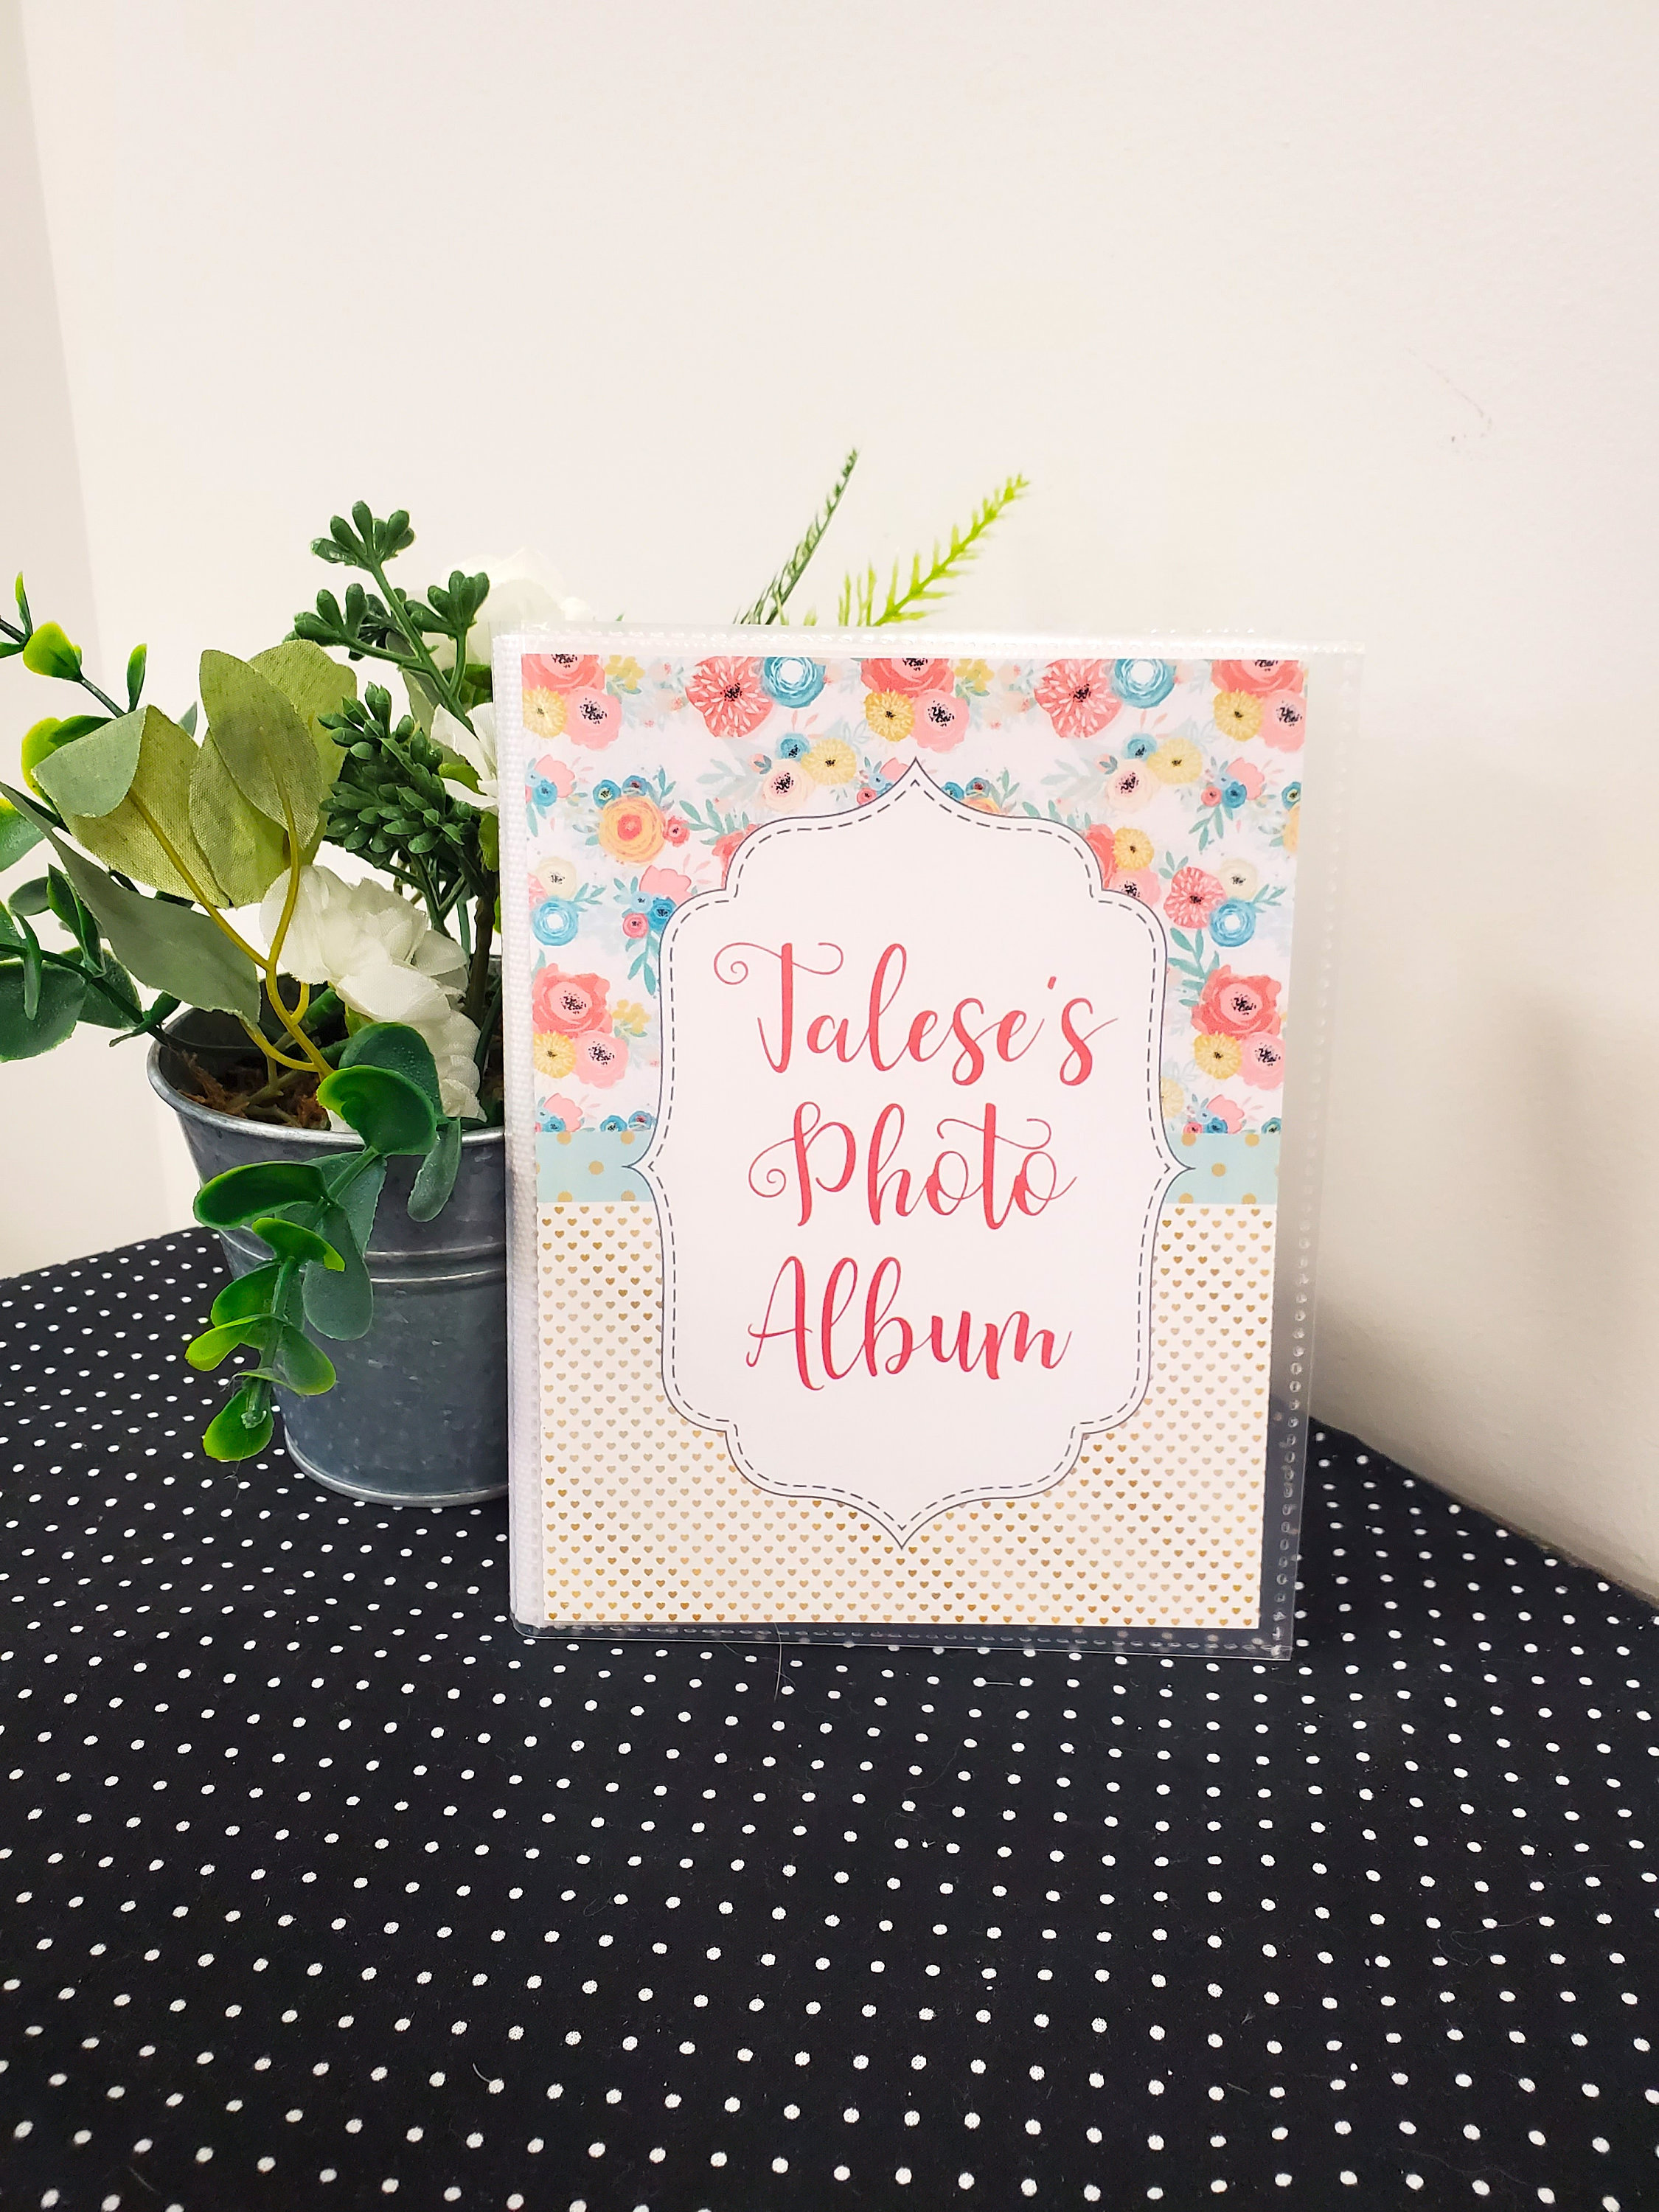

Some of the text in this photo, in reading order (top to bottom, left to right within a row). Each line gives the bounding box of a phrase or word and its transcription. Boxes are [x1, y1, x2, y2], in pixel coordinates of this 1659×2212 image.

[713, 942, 1119, 1087] Talese's
[748, 1101, 1077, 1231] Photo
[745, 1256, 1073, 1391] Album
